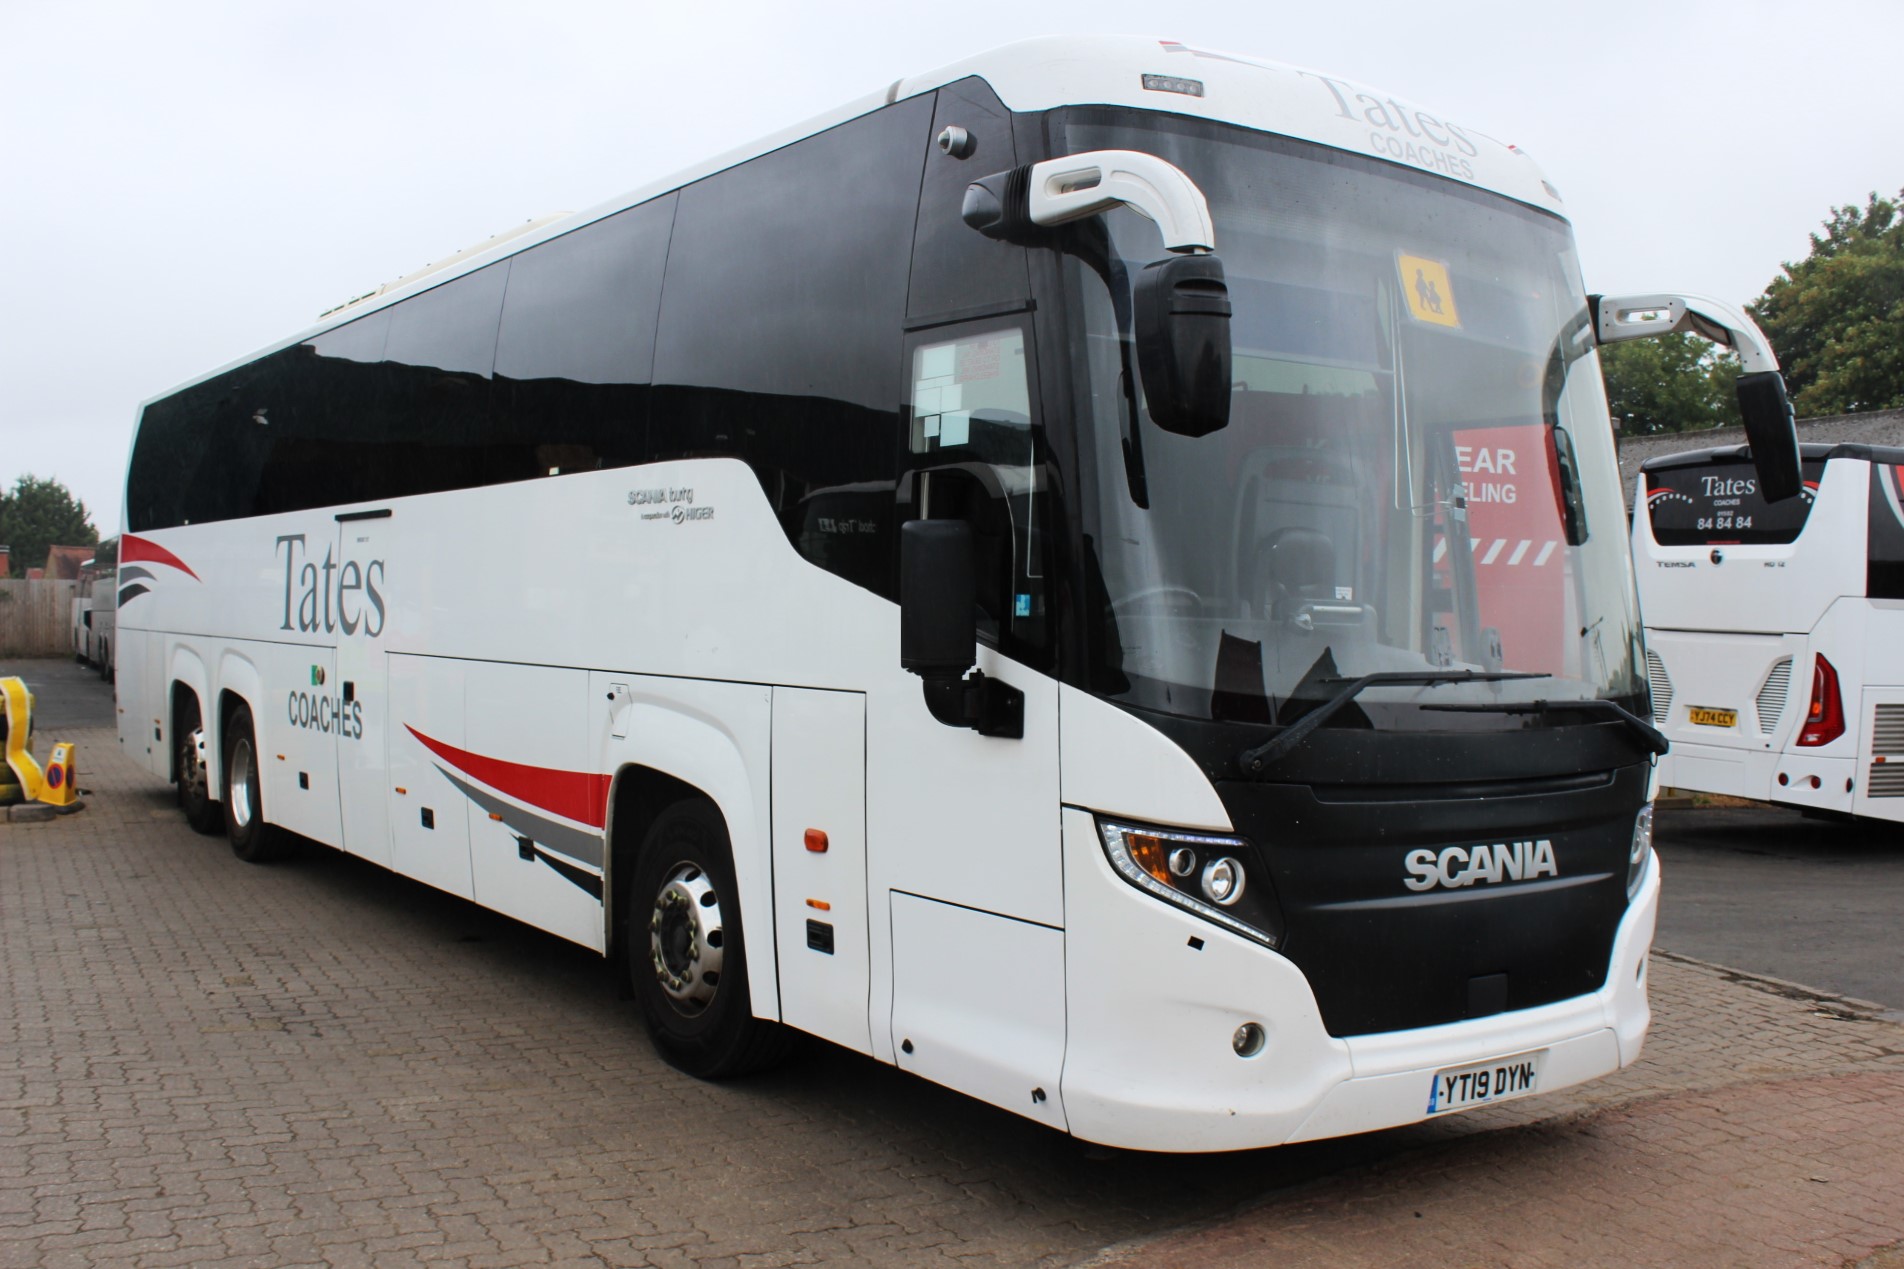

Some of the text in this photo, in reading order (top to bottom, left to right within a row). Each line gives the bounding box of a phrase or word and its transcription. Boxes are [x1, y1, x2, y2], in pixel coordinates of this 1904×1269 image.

[1296, 70, 1478, 157] Tates
[1369, 131, 1475, 181] COACHES
[1701, 476, 1756, 497] Tates
[1713, 498, 1741, 507] COACHES
[1697, 515, 1753, 530] 84 84 84
[275, 533, 386, 638] Tates
[288, 690, 363, 741] COACHES
[1717, 711, 1735, 725] CCY
[1403, 839, 1558, 892] SCANIA
[1445, 1062, 1532, 1104] YT19 DYN
